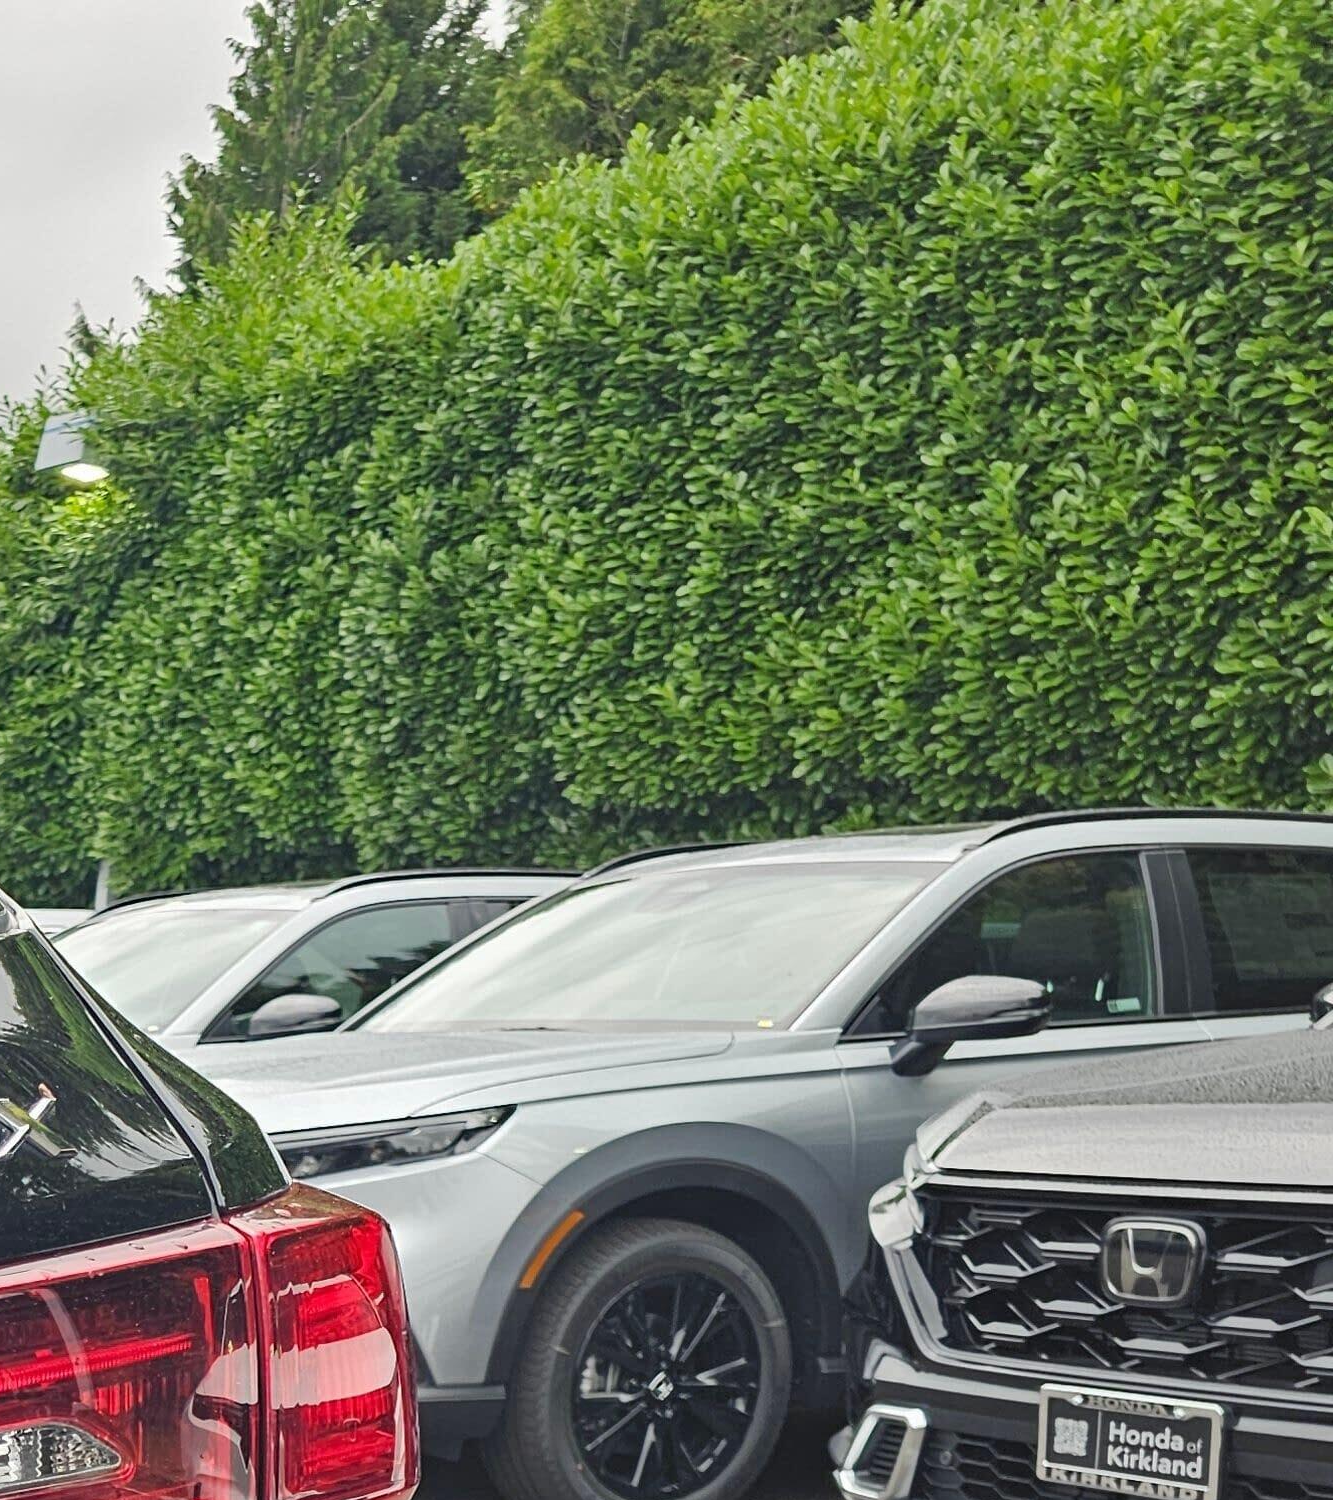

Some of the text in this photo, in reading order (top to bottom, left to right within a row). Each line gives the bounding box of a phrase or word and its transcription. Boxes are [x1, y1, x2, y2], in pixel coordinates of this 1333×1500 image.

[1087, 1396, 1169, 1416] HONDA
[1108, 1420, 1204, 1454] Honda of
[1106, 1444, 1203, 1479] Kirkland
[1050, 1469, 1199, 1500] KIRKLAND
